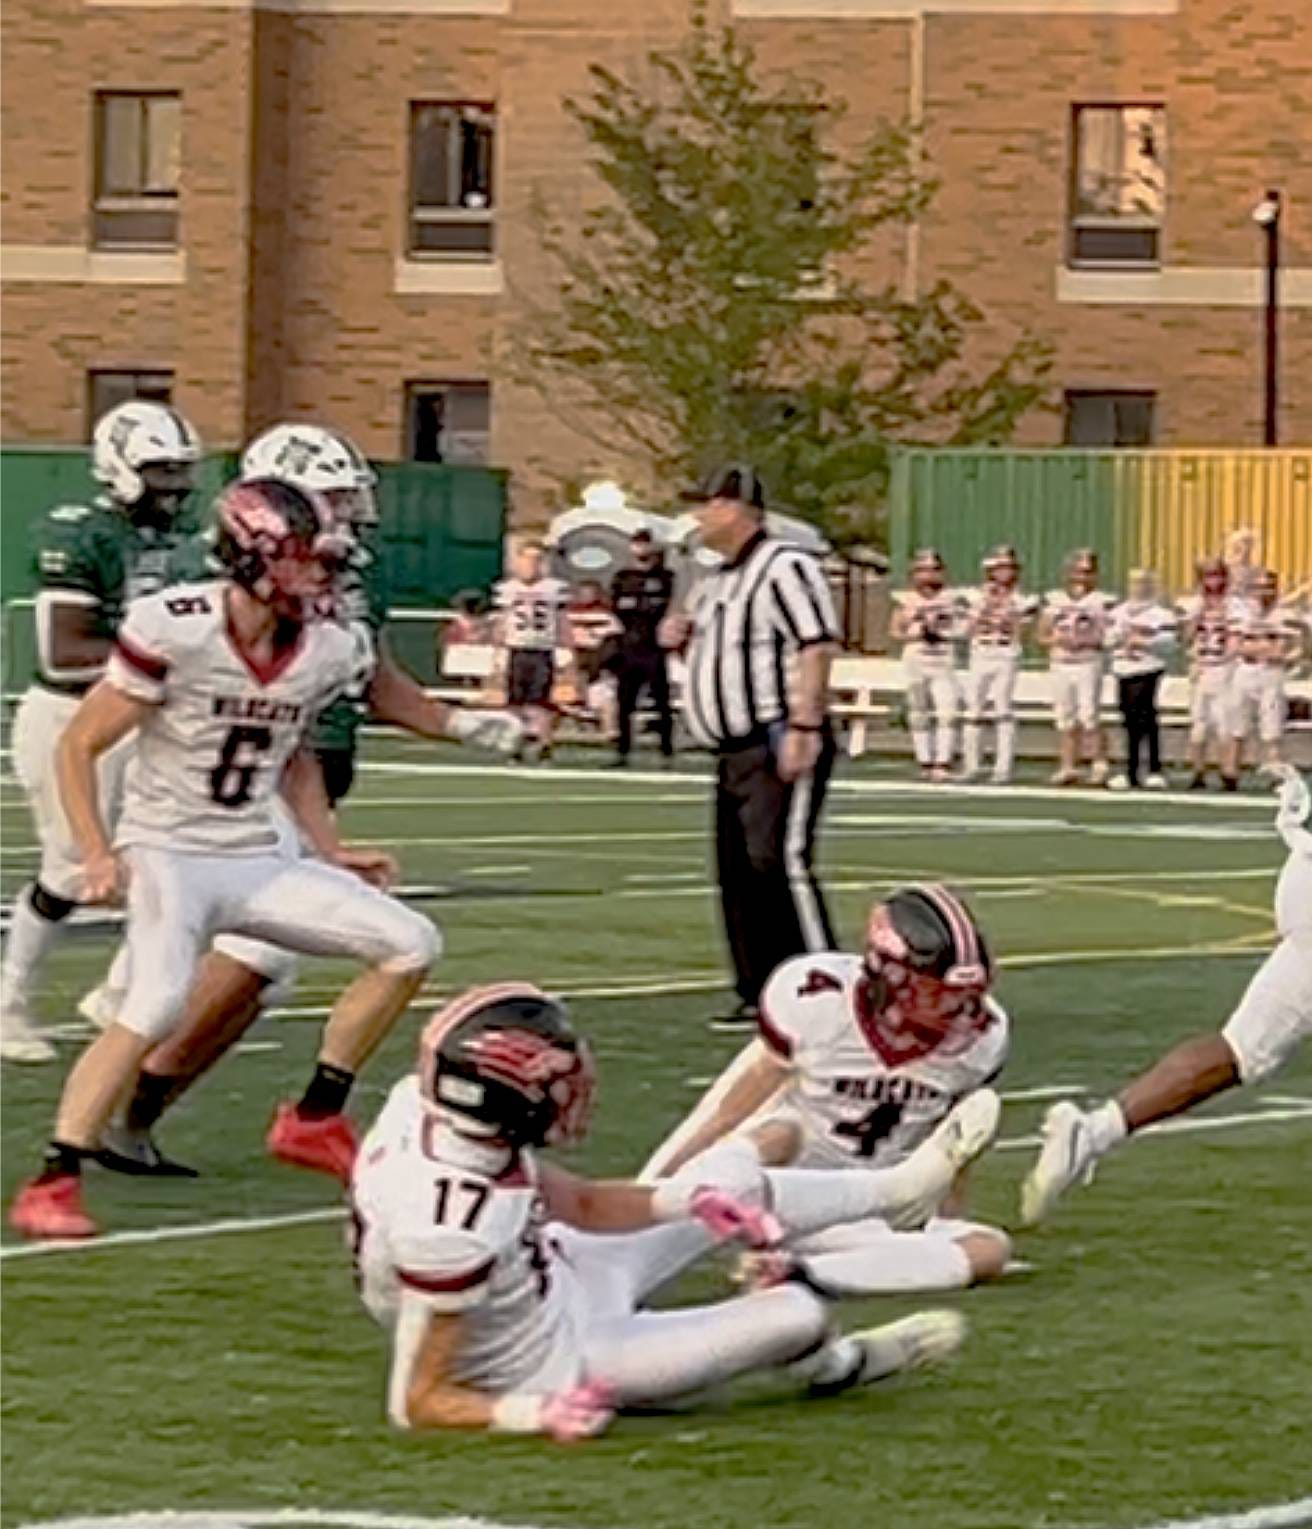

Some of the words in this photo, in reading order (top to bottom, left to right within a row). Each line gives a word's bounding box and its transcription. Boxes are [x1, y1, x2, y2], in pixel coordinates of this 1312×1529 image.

[210, 725, 272, 810] 6
[834, 1101, 905, 1157] 4
[432, 1176, 493, 1231] 17
